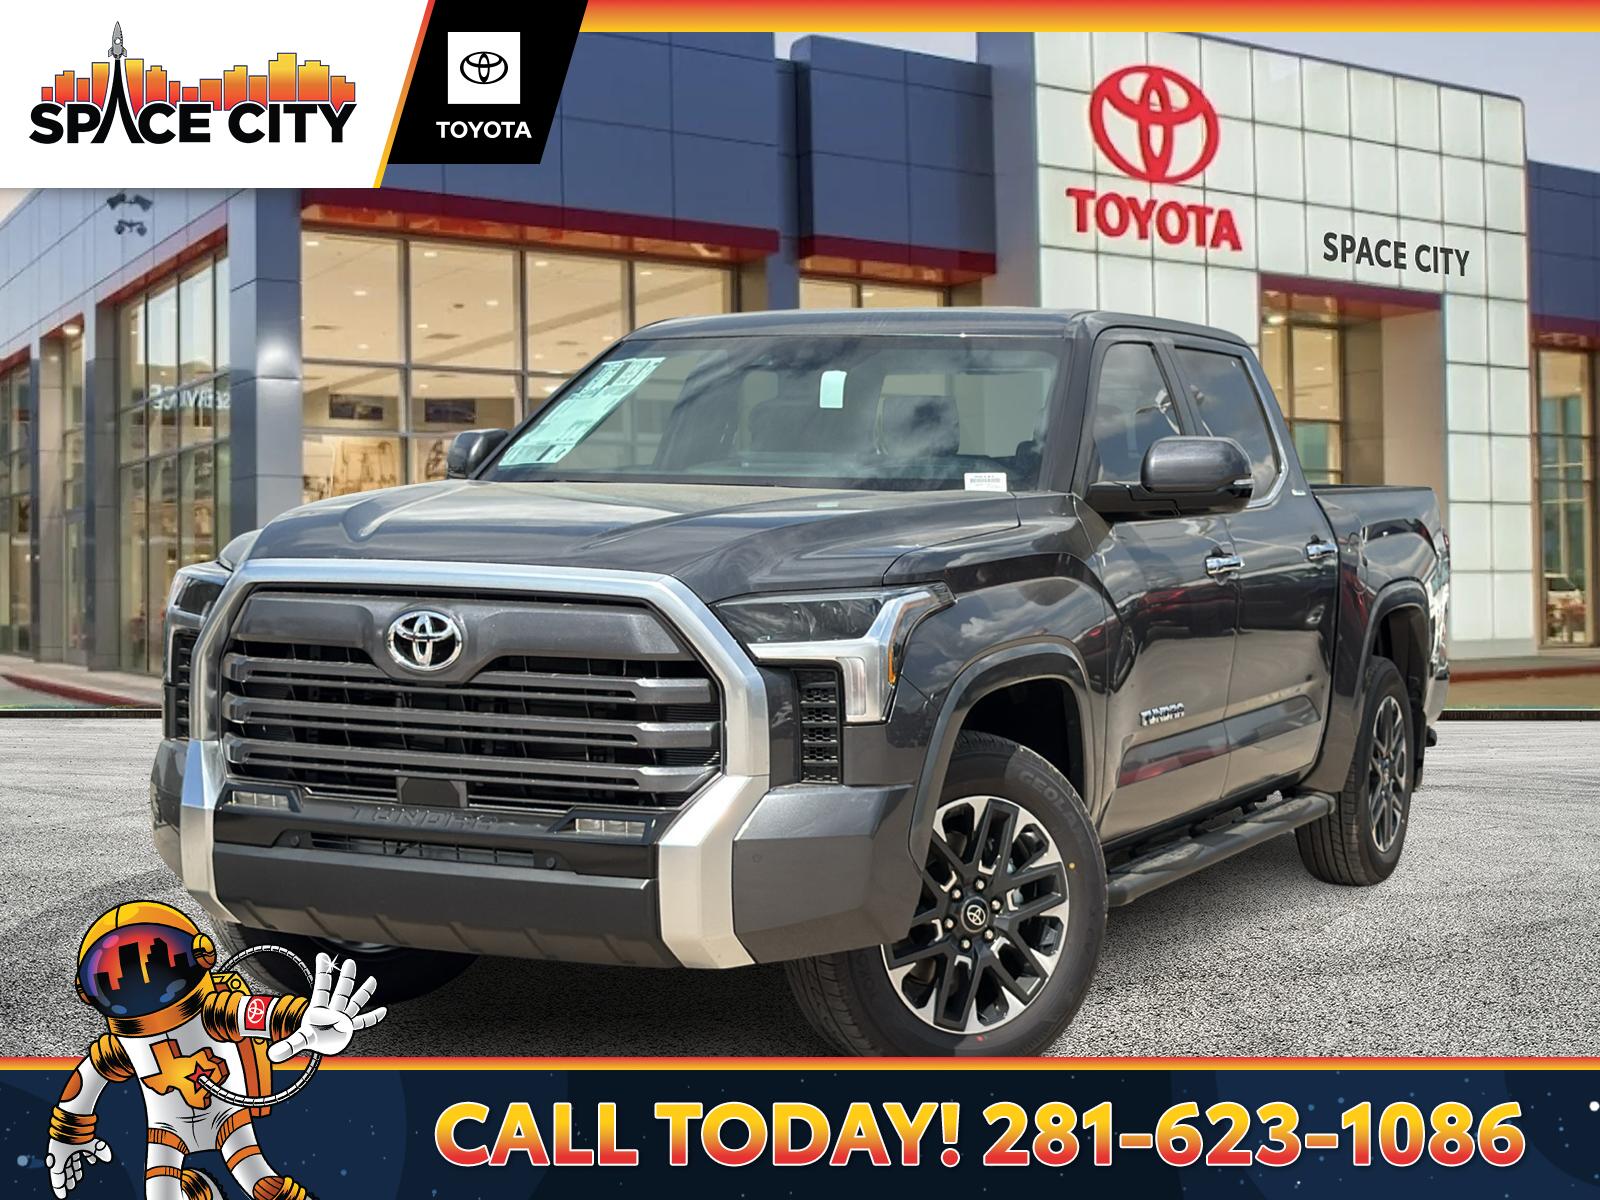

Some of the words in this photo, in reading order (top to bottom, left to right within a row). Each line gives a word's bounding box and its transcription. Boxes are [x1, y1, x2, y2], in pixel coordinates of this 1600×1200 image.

[1066, 187, 1243, 252] TOYOTA
[1323, 231, 1407, 270] SPACE
[1415, 244, 1470, 277] CITY
